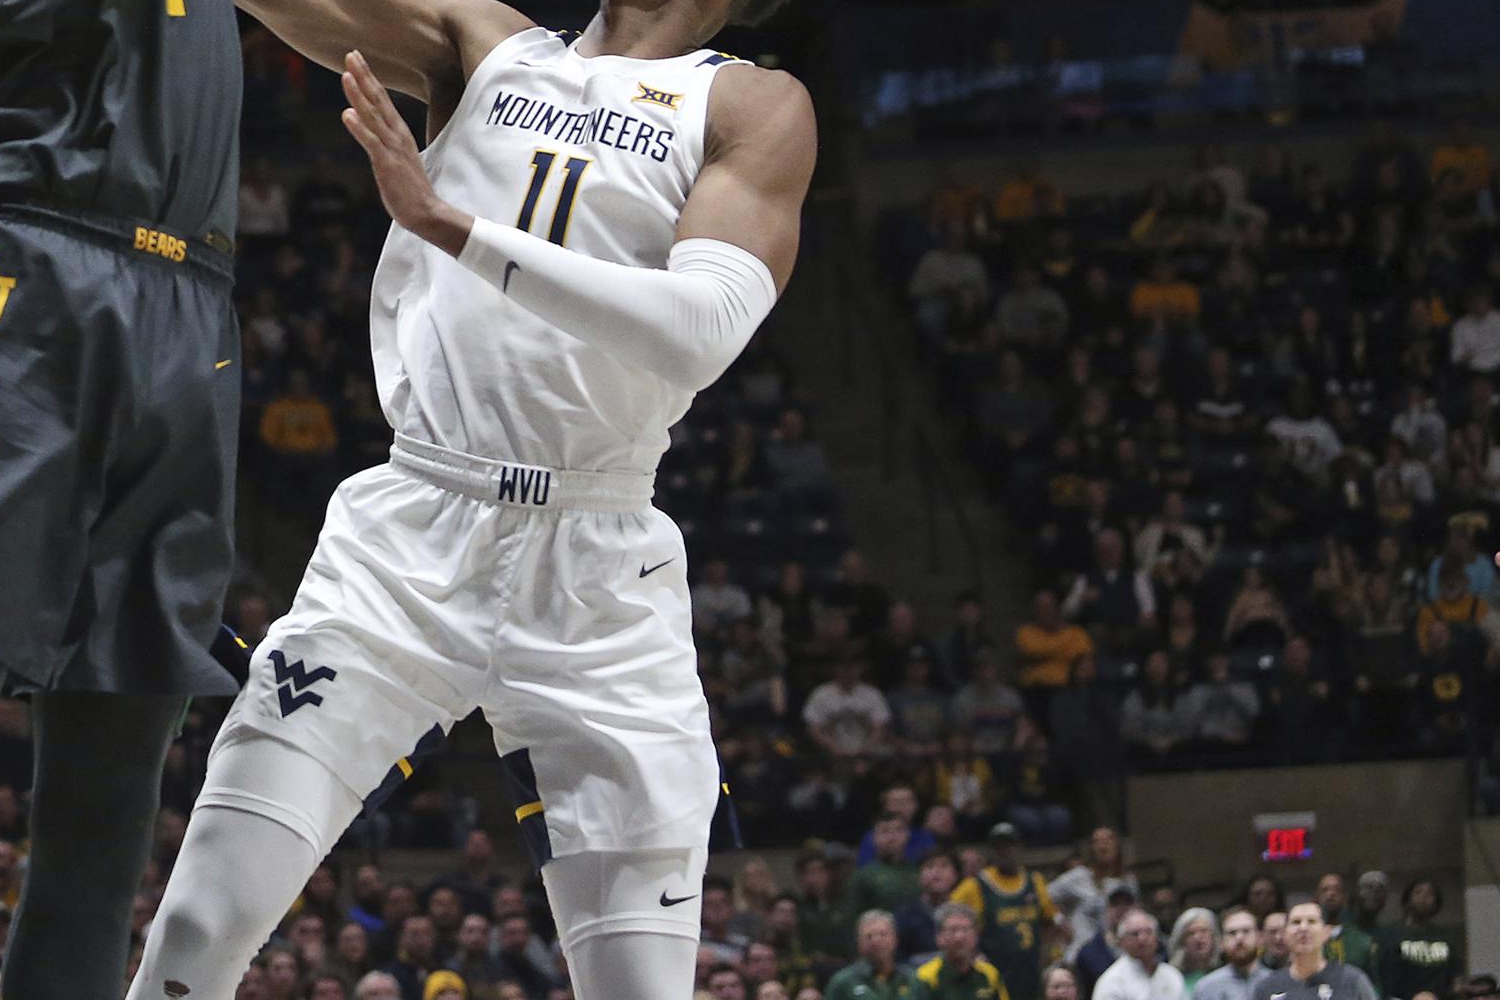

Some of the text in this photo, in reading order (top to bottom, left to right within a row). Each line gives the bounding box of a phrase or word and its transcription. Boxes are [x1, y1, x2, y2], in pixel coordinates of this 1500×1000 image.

[515, 148, 595, 249] 11
[133, 226, 188, 263] BEARS
[499, 465, 552, 506] WVU
